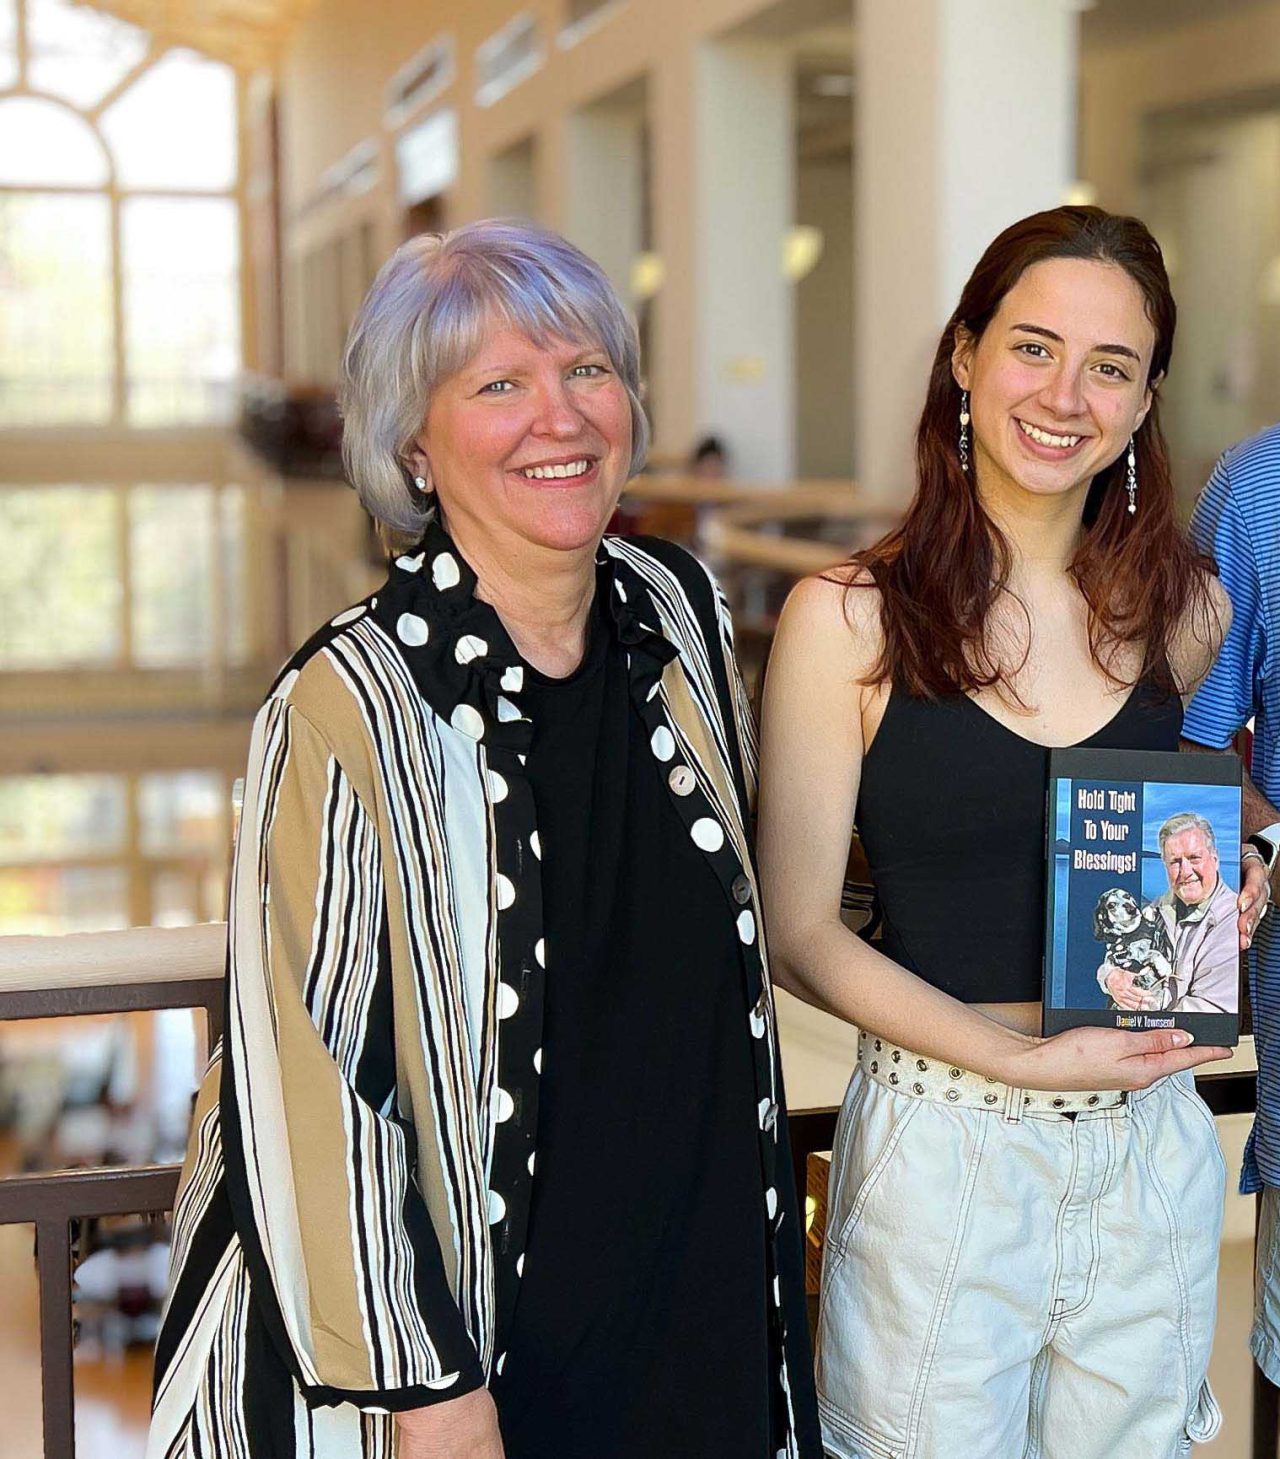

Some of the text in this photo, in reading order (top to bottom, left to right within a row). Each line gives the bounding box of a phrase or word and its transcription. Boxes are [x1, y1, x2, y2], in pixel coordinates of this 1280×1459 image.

[1078, 789, 1136, 813] Hold Tight
[1084, 819, 1129, 841] To Your
[1074, 850, 1137, 874] Blessings!
[1116, 1015, 1136, 1027] Daniel
